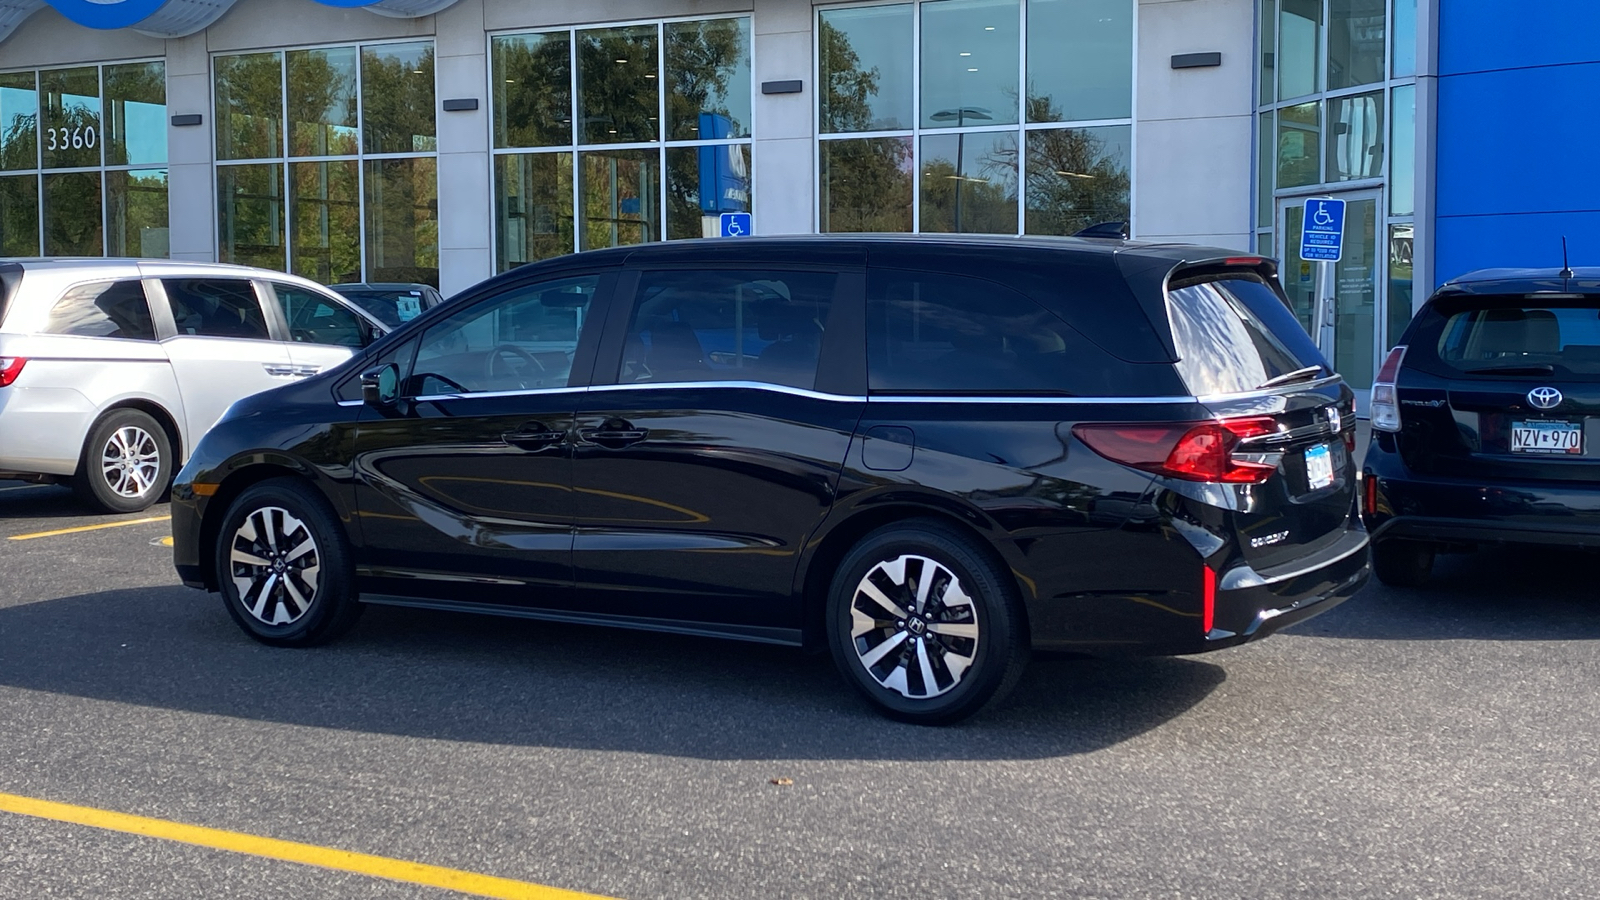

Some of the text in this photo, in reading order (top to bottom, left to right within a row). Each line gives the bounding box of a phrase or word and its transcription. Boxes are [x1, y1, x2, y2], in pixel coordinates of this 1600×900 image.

[47, 126, 96, 151] 3360
[1513, 429, 1579, 448] NZV 970
